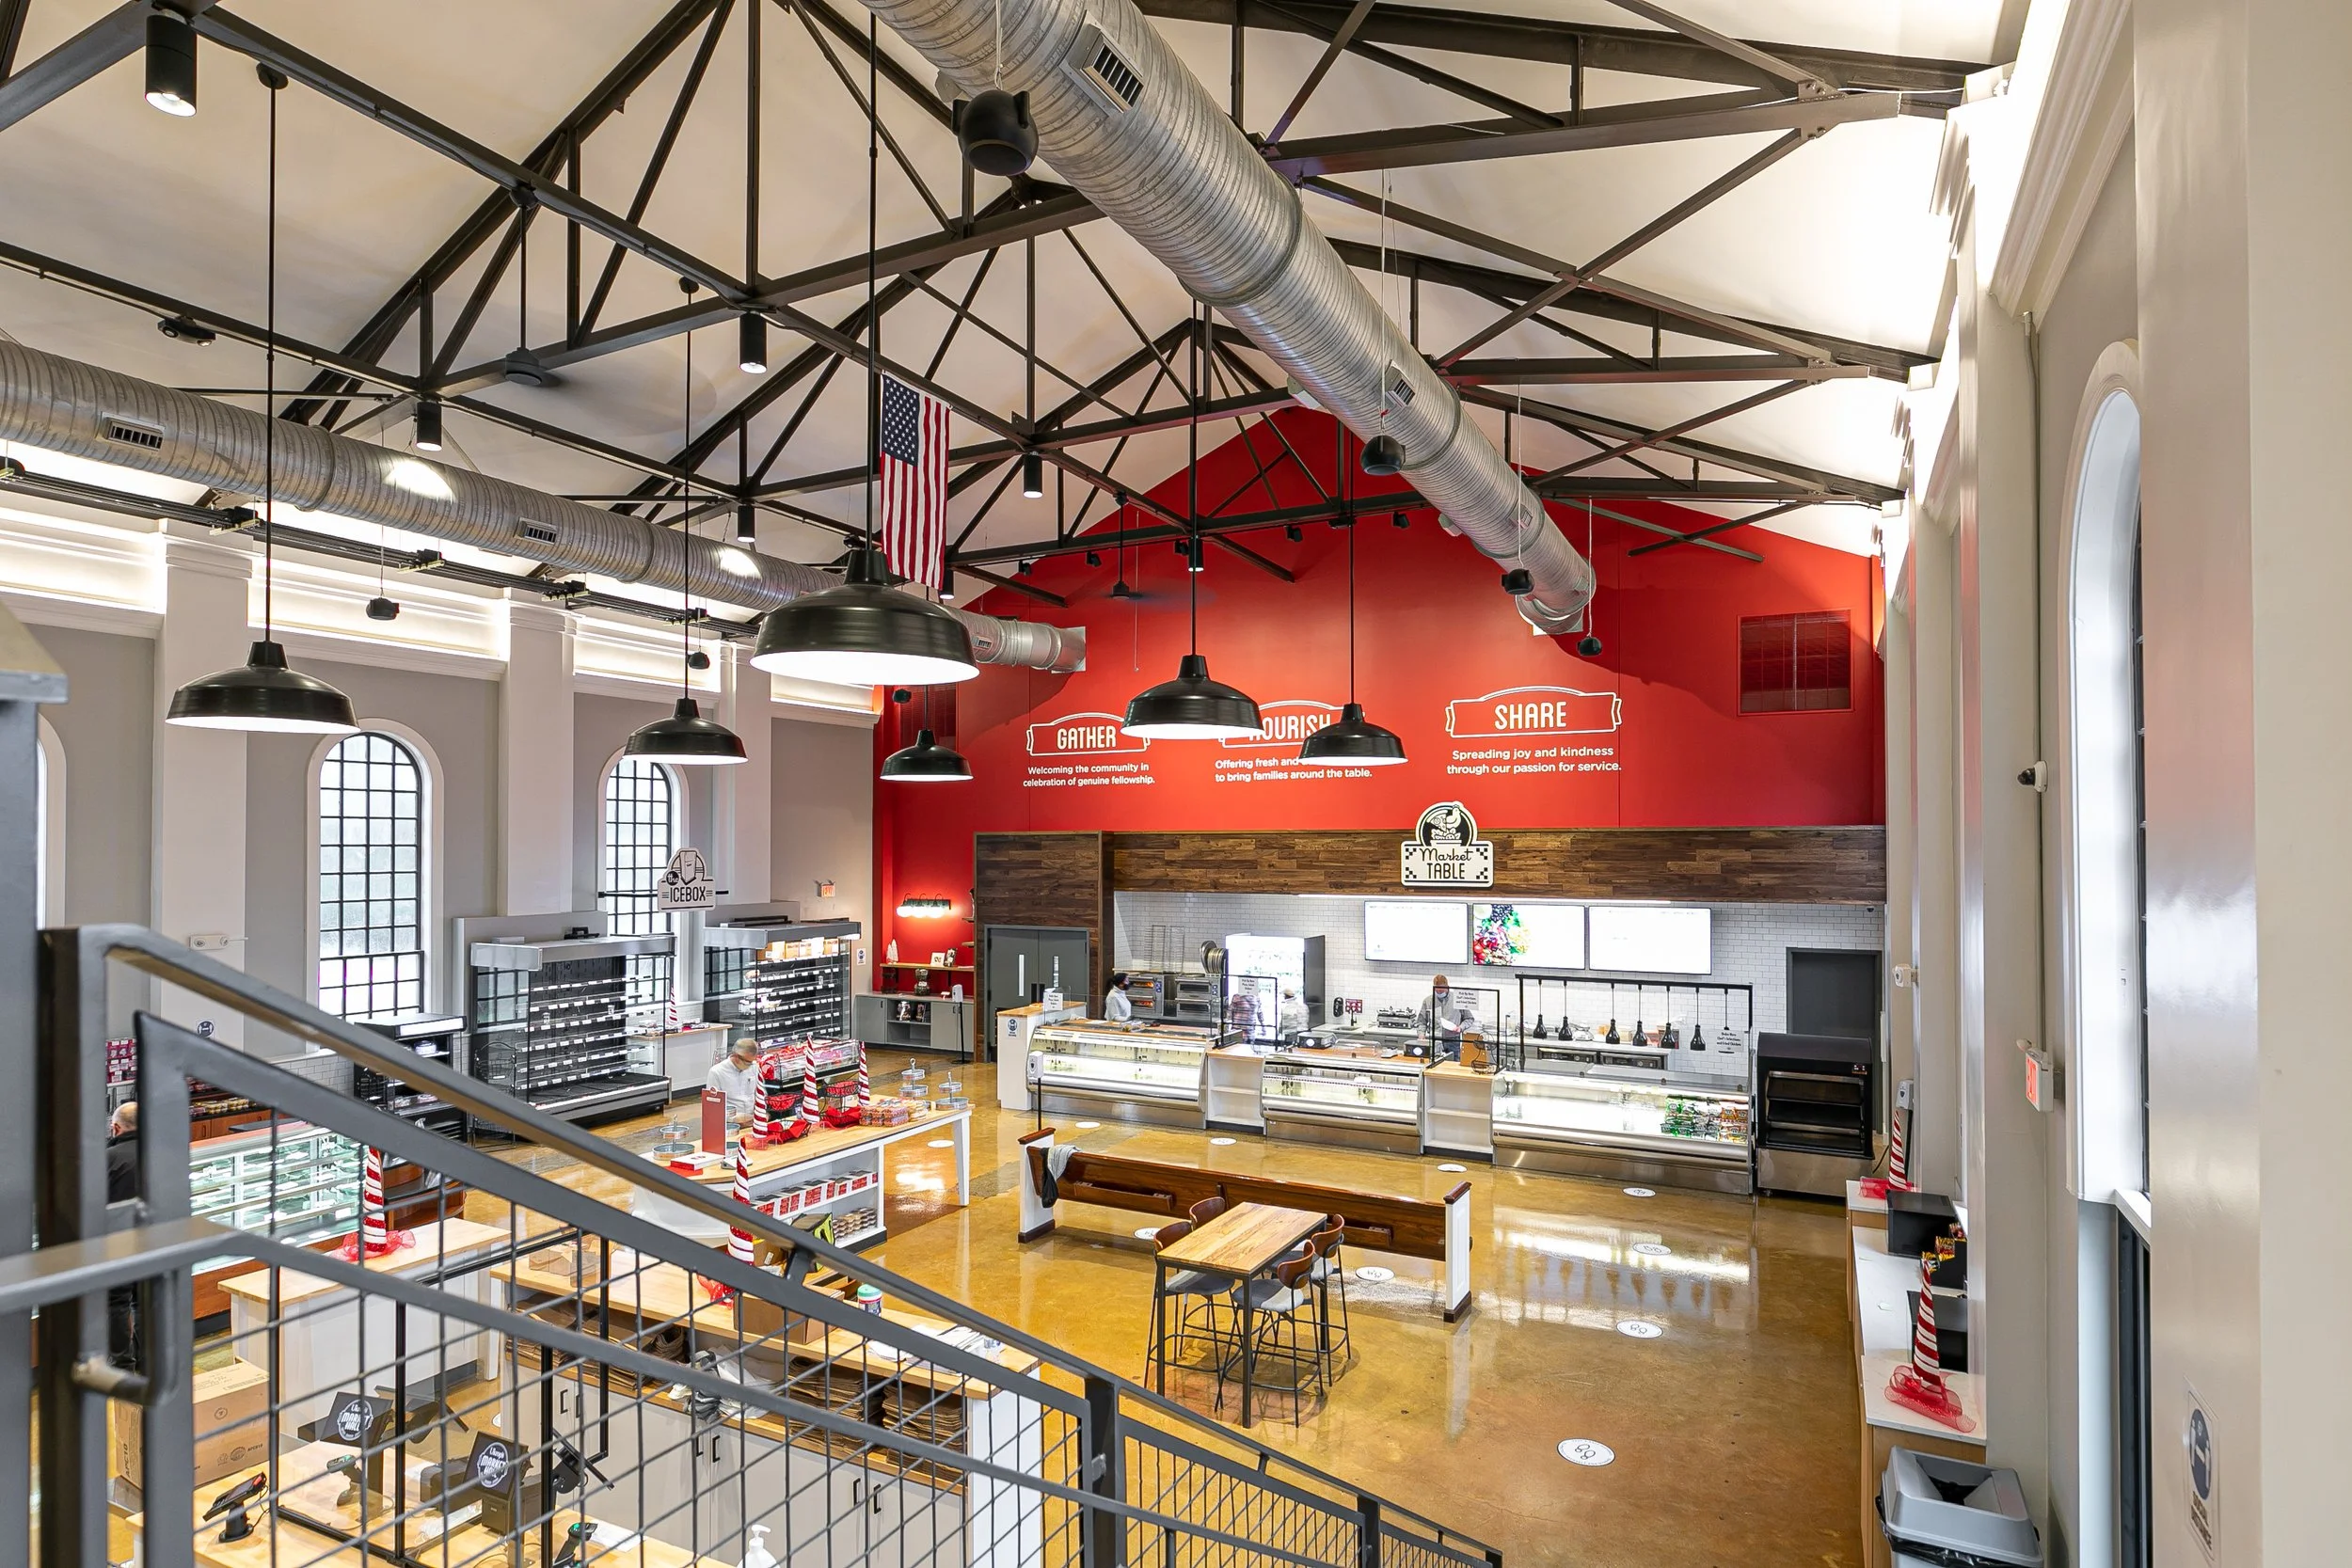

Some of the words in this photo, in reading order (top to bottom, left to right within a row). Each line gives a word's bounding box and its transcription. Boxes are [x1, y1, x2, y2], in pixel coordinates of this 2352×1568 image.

[1494, 701, 1567, 730] SHARE
[1249, 713, 1331, 741] OURISH
[1057, 725, 1117, 750] GATHER
[1452, 749, 1511, 761] Spreading
[1512, 749, 1532, 760] joy
[1534, 747, 1557, 757] and
[1560, 746, 1614, 757] kindness
[1027, 766, 1073, 775] Welcoming
[1075, 765, 1089, 773] the
[1090, 763, 1138, 773] community
[1140, 763, 1150, 771] in
[1215, 758, 1253, 769] Offering
[1255, 757, 1279, 767] fresh
[1280, 756, 1299, 766] and
[1446, 764, 1489, 775] through
[1492, 765, 1511, 773] our
[1513, 762, 1556, 774] passion
[1558, 762, 1576, 772] for
[1578, 761, 1622, 772] service.
[1023, 777, 1066, 786] celebration
[1067, 777, 1077, 785] of
[1077, 777, 1109, 787] genuine
[1111, 775, 1155, 785] fellowship.
[1215, 773, 1224, 782] to
[1227, 771, 1251, 783] bring
[1253, 770, 1289, 781] families
[1290, 768, 1325, 780] around
[1327, 768, 1343, 778] the
[1344, 768, 1373, 778] table.
[1419, 847, 1474, 862] Market
[667, 874, 679, 883] the
[1426, 863, 1466, 879] TABLE
[670, 886, 707, 903] ICEBOX
